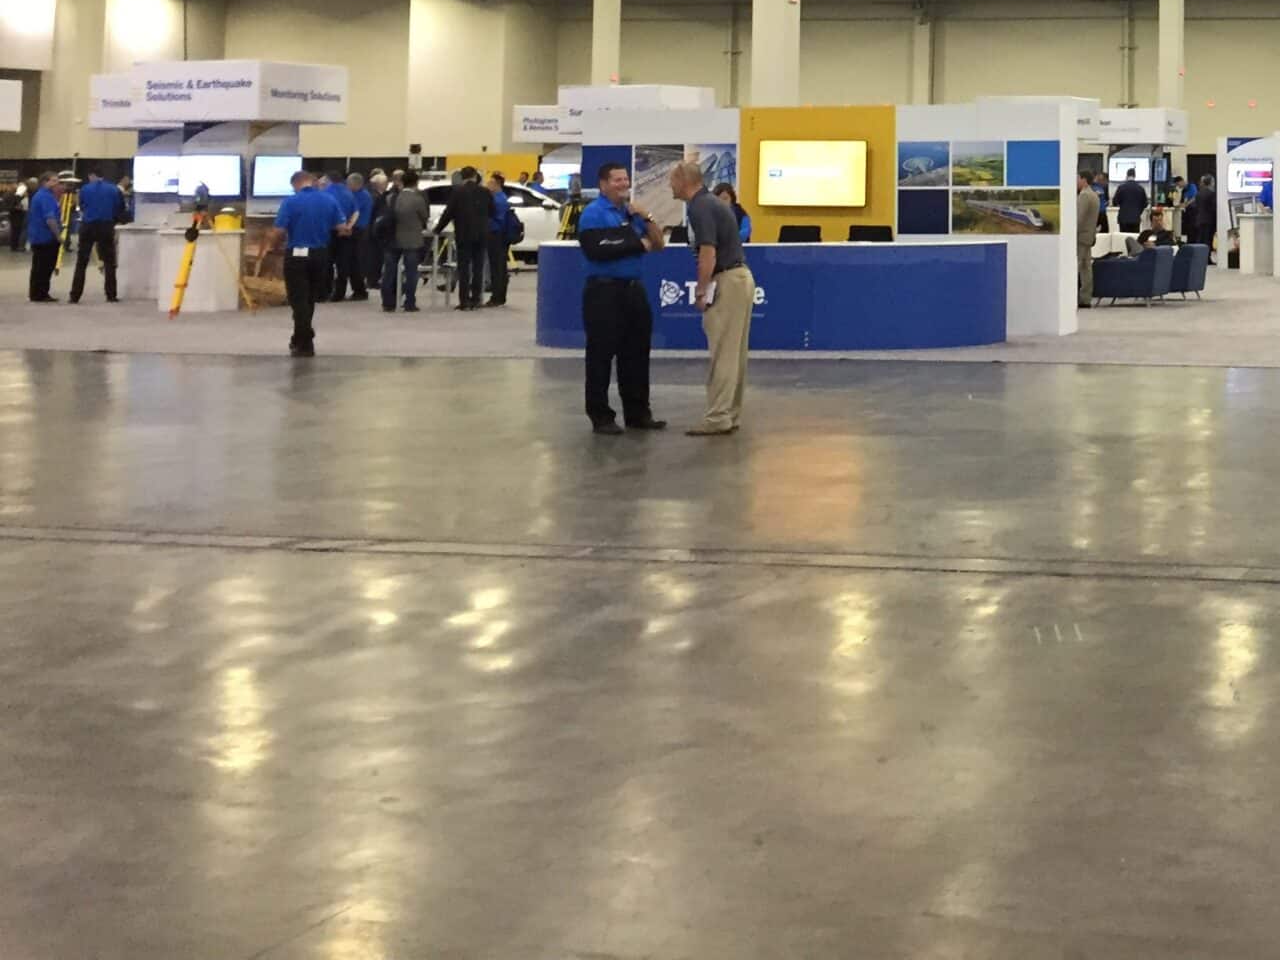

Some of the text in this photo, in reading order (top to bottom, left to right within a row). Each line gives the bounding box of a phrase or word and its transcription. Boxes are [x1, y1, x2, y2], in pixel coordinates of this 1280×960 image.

[146, 79, 253, 90] Seismic & Earthquake
[146, 91, 192, 102] Solutions
